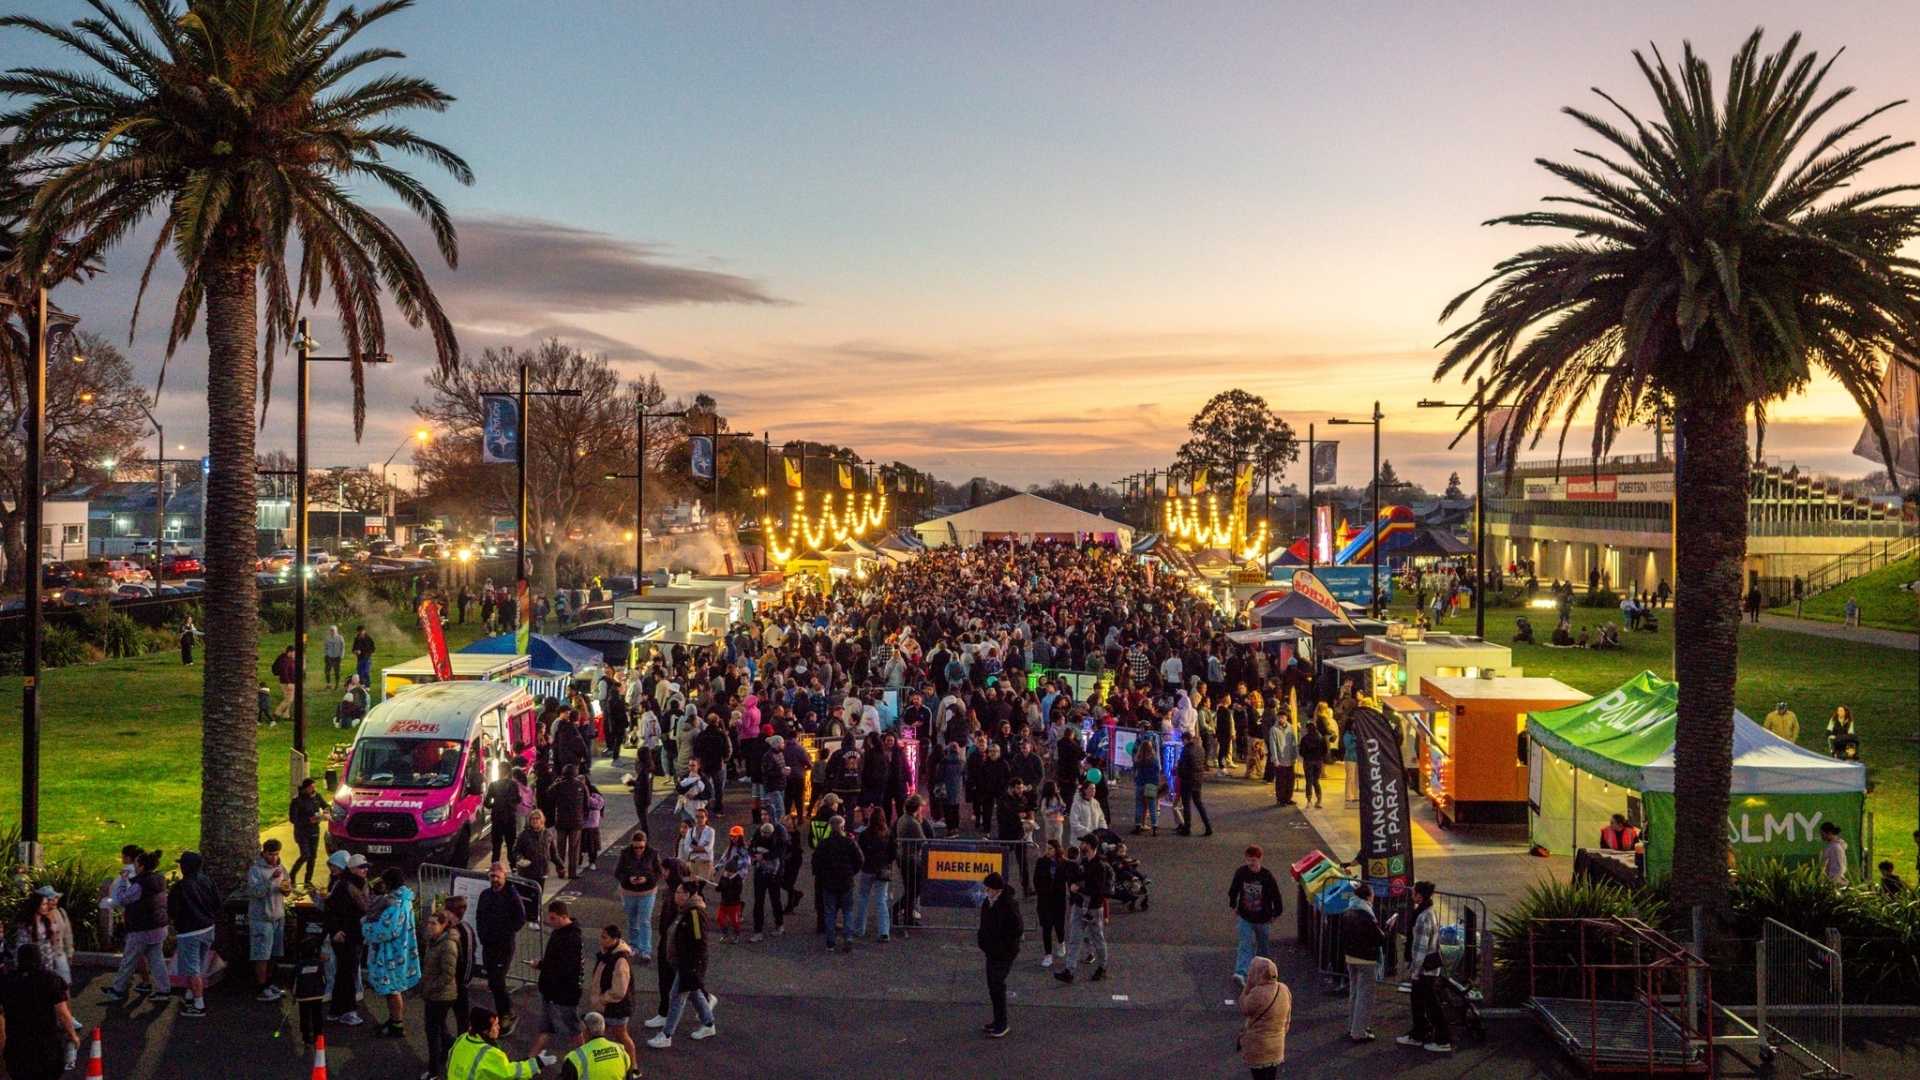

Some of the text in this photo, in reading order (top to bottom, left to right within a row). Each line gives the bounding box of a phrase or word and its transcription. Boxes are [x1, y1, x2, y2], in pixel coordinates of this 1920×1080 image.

[1367, 738, 1387, 853] HANGARAU
[1386, 779, 1401, 835] PARA
[1727, 810, 1823, 843] LMY
[936, 861, 994, 873] HAERE MAI
